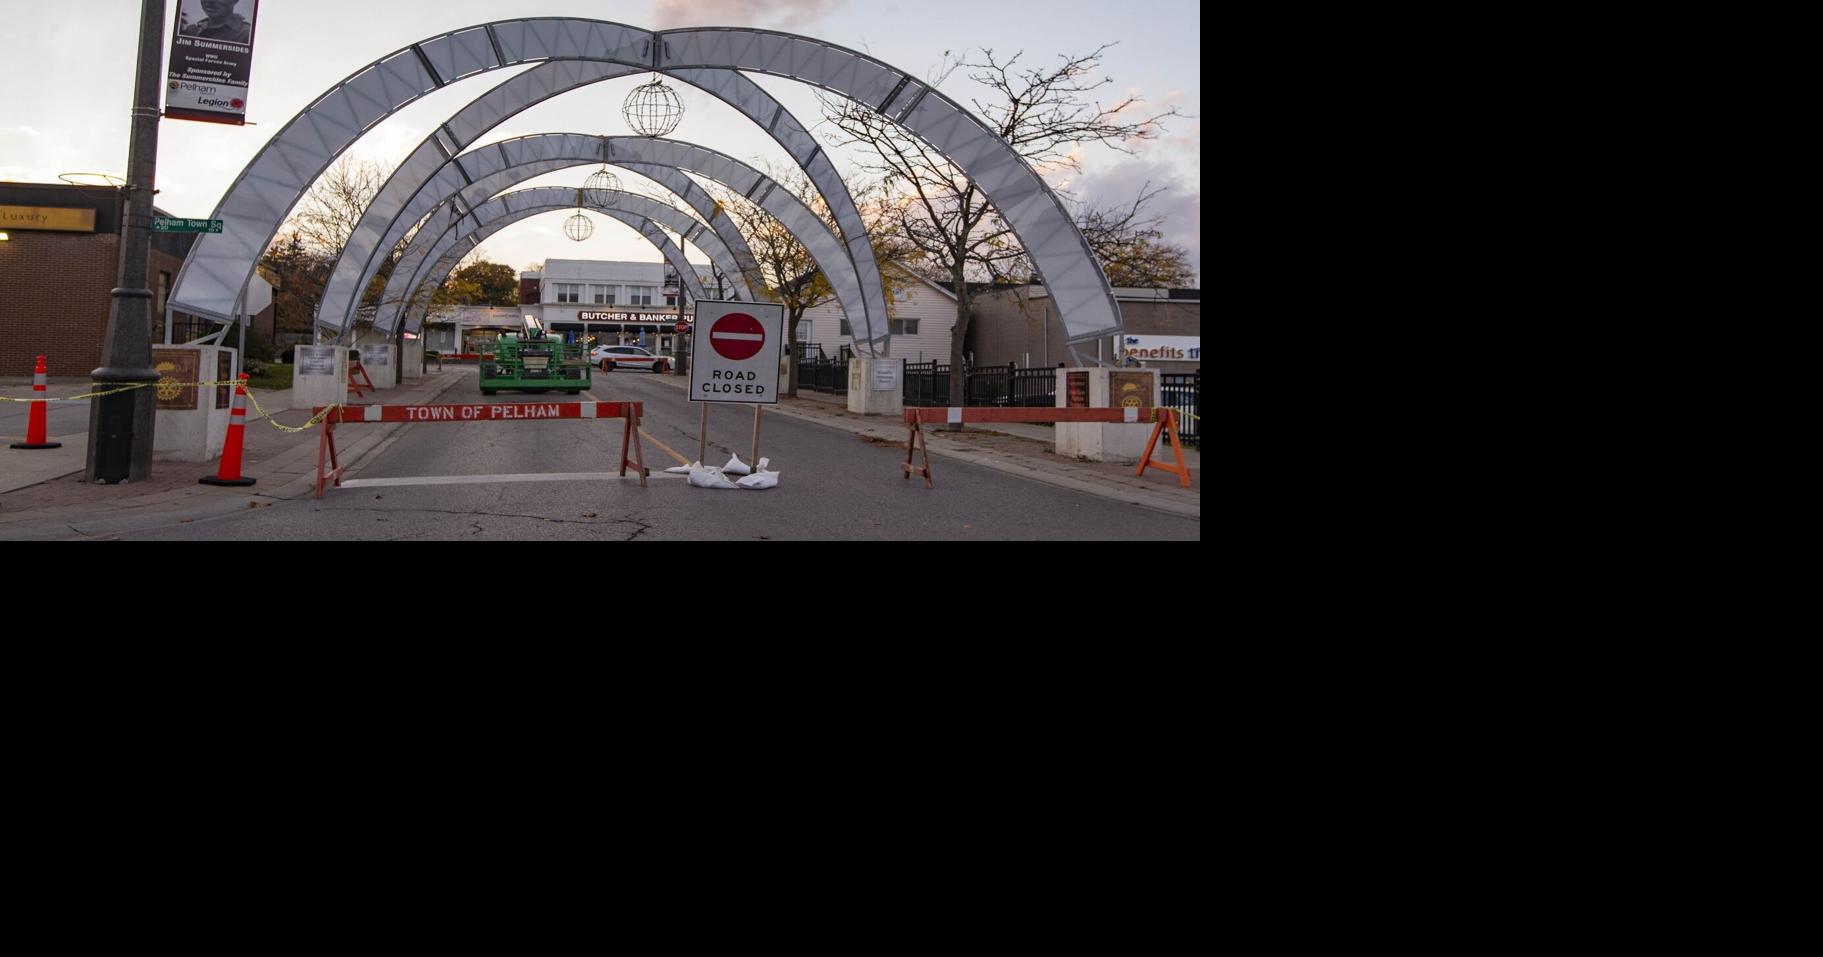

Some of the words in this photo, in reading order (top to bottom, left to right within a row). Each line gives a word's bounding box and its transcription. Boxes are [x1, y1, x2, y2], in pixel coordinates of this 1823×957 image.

[176, 38, 192, 46] JIM
[194, 39, 250, 54] SUMMERSIDES
[185, 55, 205, 63] Special
[187, 67, 222, 77] Sponsored
[181, 73, 227, 84] Summersides
[227, 78, 249, 88] Family
[180, 81, 217, 93] Pelham
[198, 96, 229, 107] Legion
[2, 211, 48, 223] Luxury
[154, 216, 184, 227] Pelham
[188, 219, 208, 228] Town
[211, 221, 222, 231] Sq
[582, 312, 627, 321] BUTCHER
[630, 313, 637, 321] &
[1126, 336, 1139, 345] the
[712, 369, 757, 381] ROAD
[702, 382, 766, 395] CLOSED
[406, 406, 454, 420] TOWN
[461, 406, 482, 418] OF
[491, 404, 560, 418] PELHAM
